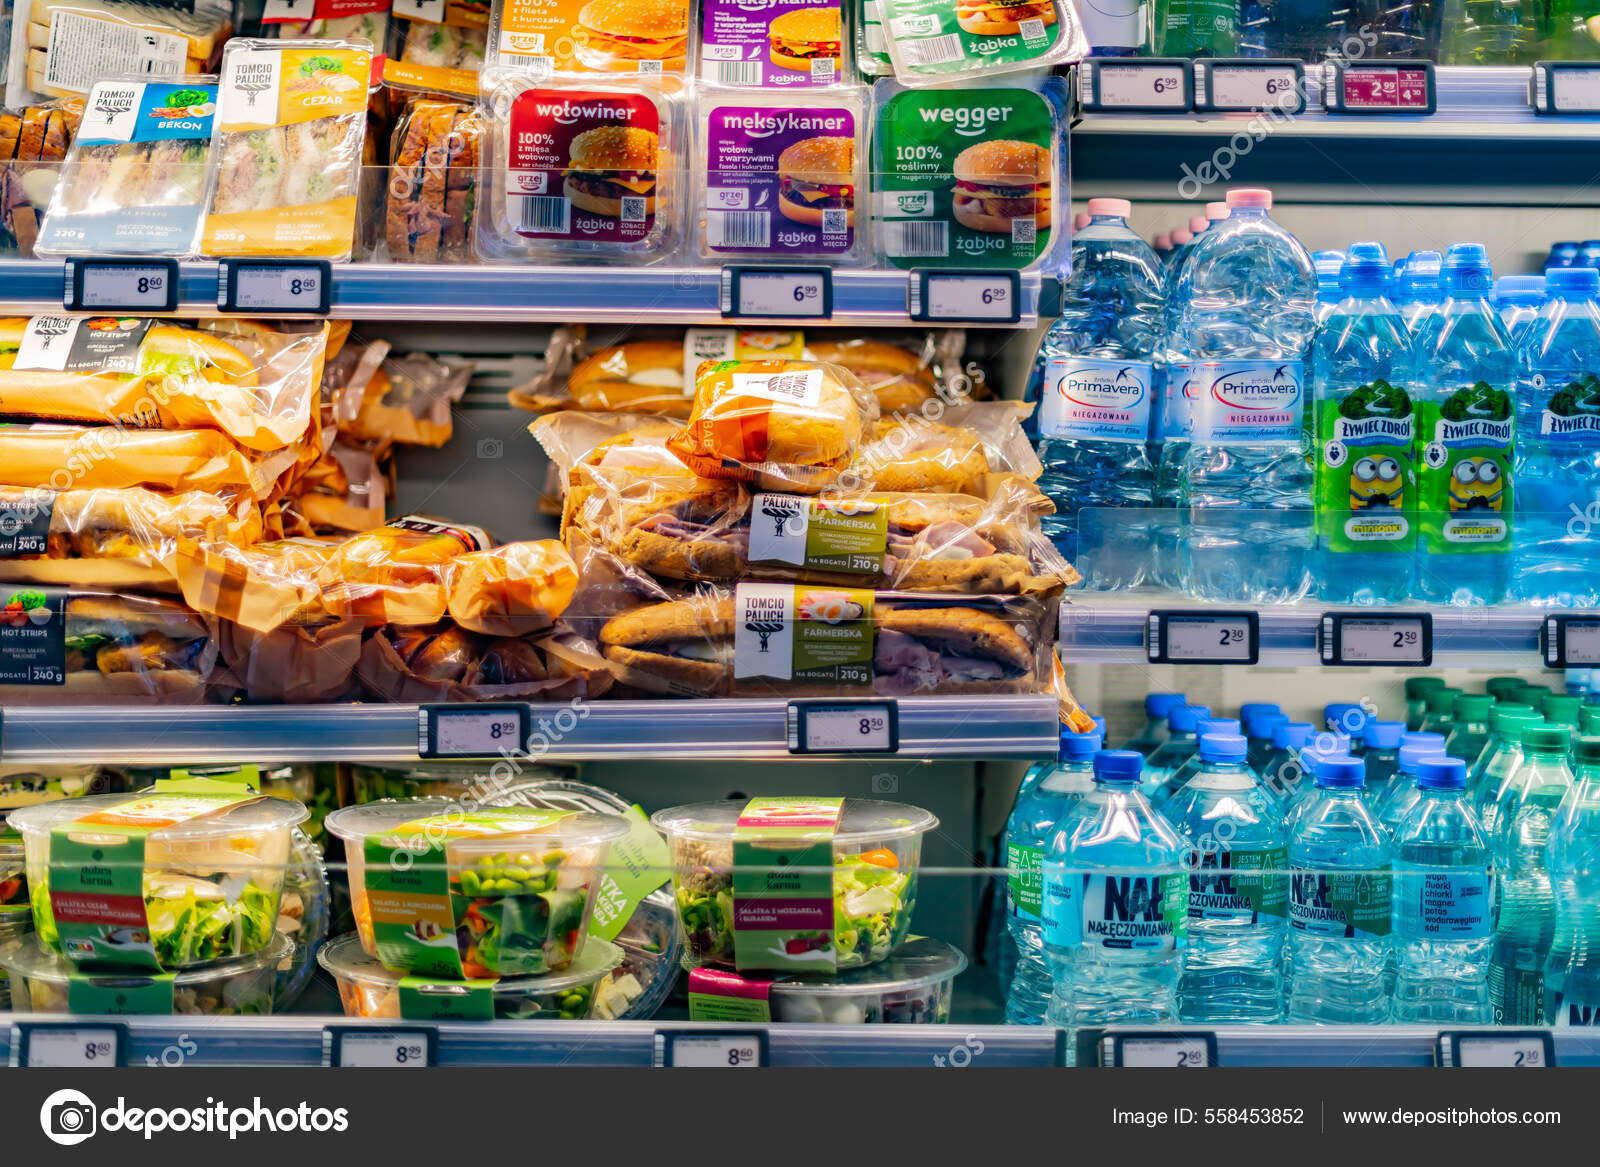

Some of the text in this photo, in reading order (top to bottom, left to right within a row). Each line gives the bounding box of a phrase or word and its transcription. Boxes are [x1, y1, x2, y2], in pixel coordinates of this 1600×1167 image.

[520, 7, 547, 15] fileta
[519, 15, 565, 24] kurczaka
[510, 34, 538, 45] grzej
[969, 37, 1018, 52] żabka
[236, 64, 273, 75] TOMCIO
[235, 74, 271, 84] PALUCH
[98, 90, 135, 100] TOMCIO
[302, 95, 343, 106] CEZAR
[96, 98, 133, 108] PALUCH
[536, 101, 636, 120] wołowiner
[919, 106, 1013, 127] wegger
[157, 121, 202, 131] BEKON
[724, 112, 846, 134] meksykaner
[518, 132, 554, 145] 100%
[525, 145, 550, 154] mięsa
[719, 146, 753, 154] wołowe
[896, 146, 943, 160] 100%
[518, 153, 560, 163] wołowego
[725, 154, 774, 163] warzywami
[896, 160, 940, 172] roślinny
[518, 174, 542, 185] grzej
[719, 190, 743, 201] grzej
[897, 192, 928, 207] grzej
[576, 217, 615, 230] żabka
[777, 231, 816, 243] żabka
[956, 235, 1005, 250] żabka
[36, 319, 71, 329] PALUCH
[1068, 380, 1140, 396] Primavera
[1223, 382, 1297, 395] Primavera
[1072, 411, 1130, 421] NIEGAZOWANA
[1343, 418, 1411, 437] ŻYWIEC ZDRÓJ
[1443, 420, 1512, 440] ŻYWIEC ZDRÓJ
[1551, 416, 1588, 433] ŻYWIEC
[762, 496, 801, 509] PALUCH
[819, 518, 877, 530] FARMERSKA
[18, 540, 46, 551] 240 g
[853, 559, 879, 572] 210 g
[745, 597, 785, 609] TOMCIO
[745, 610, 784, 622] PALUCH
[1, 629, 48, 638] HOT STRIPS
[804, 627, 863, 639] FARMERSKA
[33, 670, 63, 682] 240 g
[841, 670, 868, 681] 210 g
[1425, 881, 1451, 890] fluorki
[1104, 876, 1165, 922] NAŁ
[1425, 889, 1453, 898] chlorki
[1425, 899, 1455, 908] magnez
[1425, 907, 1448, 916] potas
[1087, 920, 1174, 938] NAŁĘCZOWIANKA
[1425, 924, 1440, 932] sód
